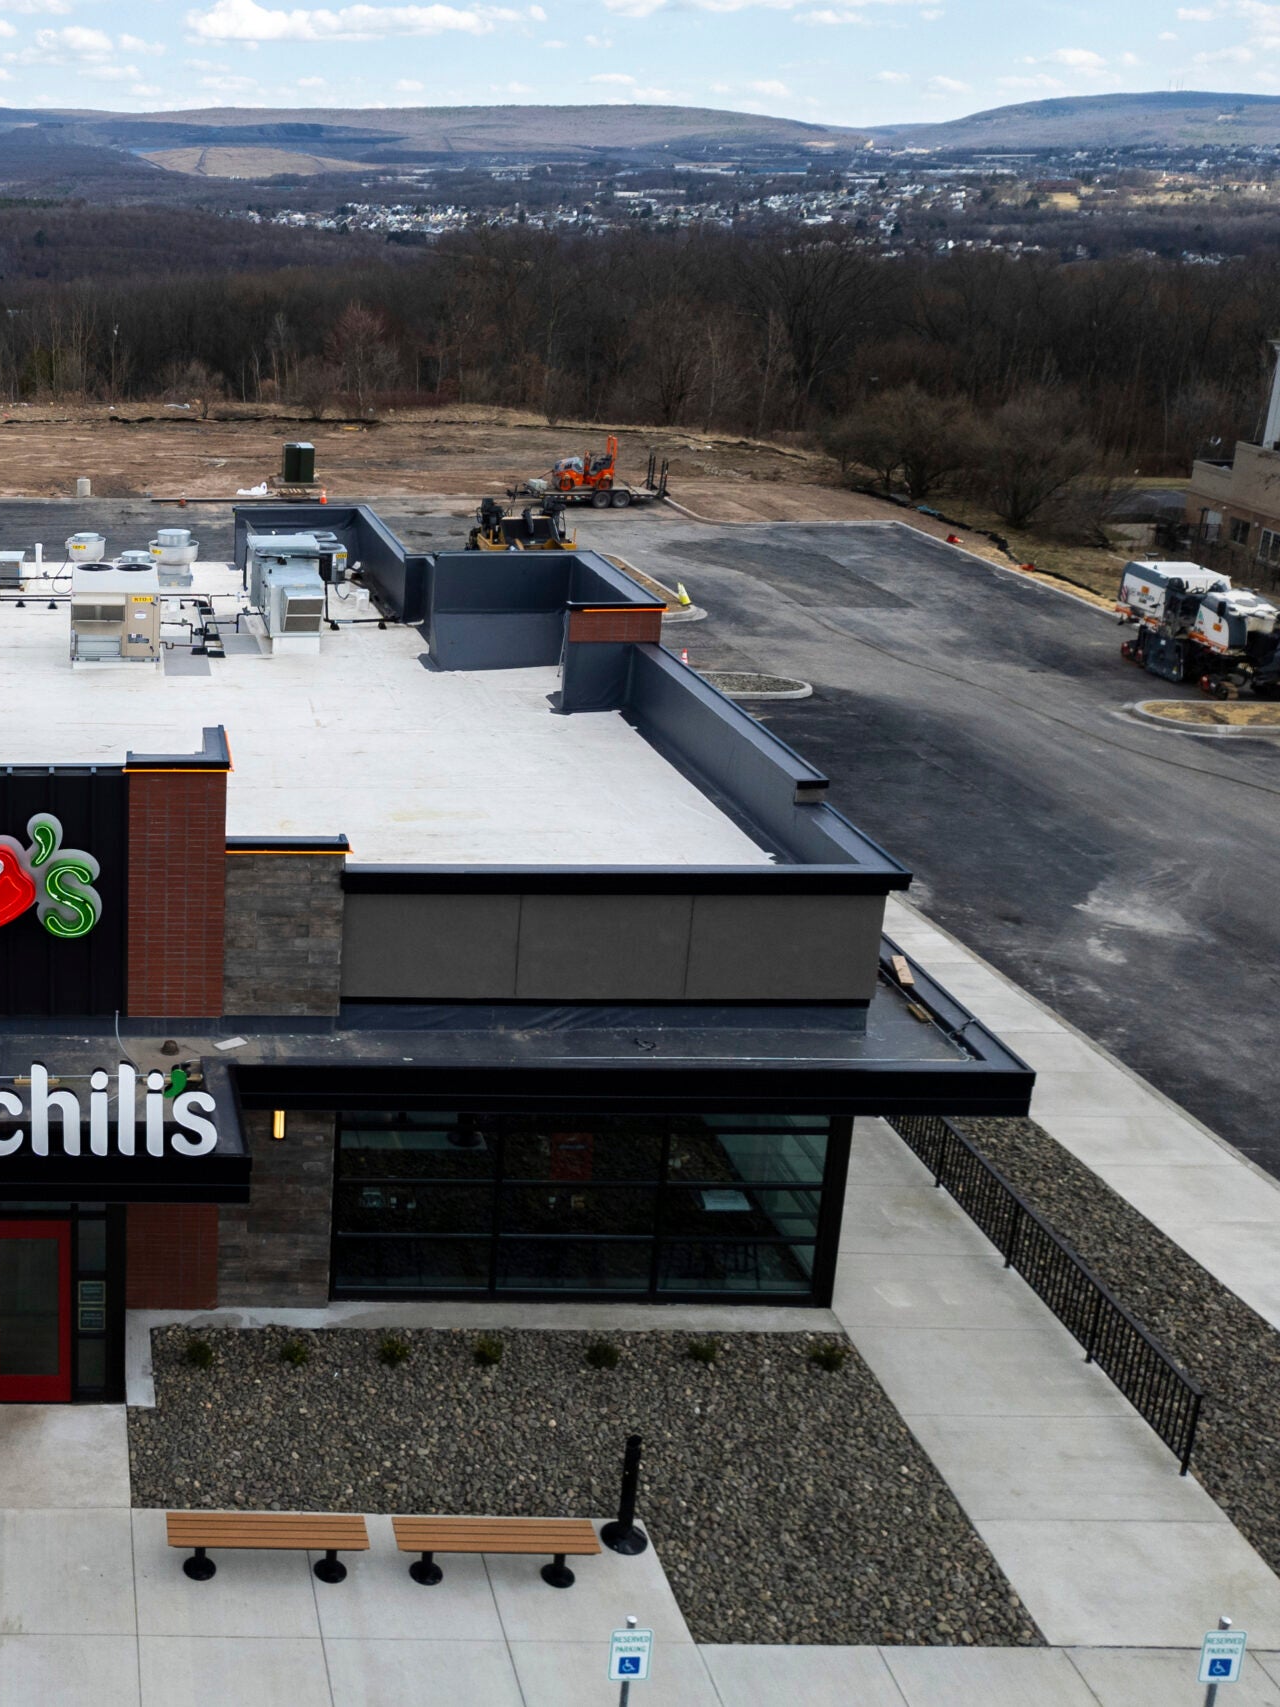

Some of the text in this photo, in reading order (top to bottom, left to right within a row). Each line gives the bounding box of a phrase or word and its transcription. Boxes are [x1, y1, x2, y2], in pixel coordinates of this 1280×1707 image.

[612, 1635, 650, 1643] RESERVED
[1206, 1637, 1243, 1645] RESERVED
[1207, 1647, 1239, 1655] PARKING
